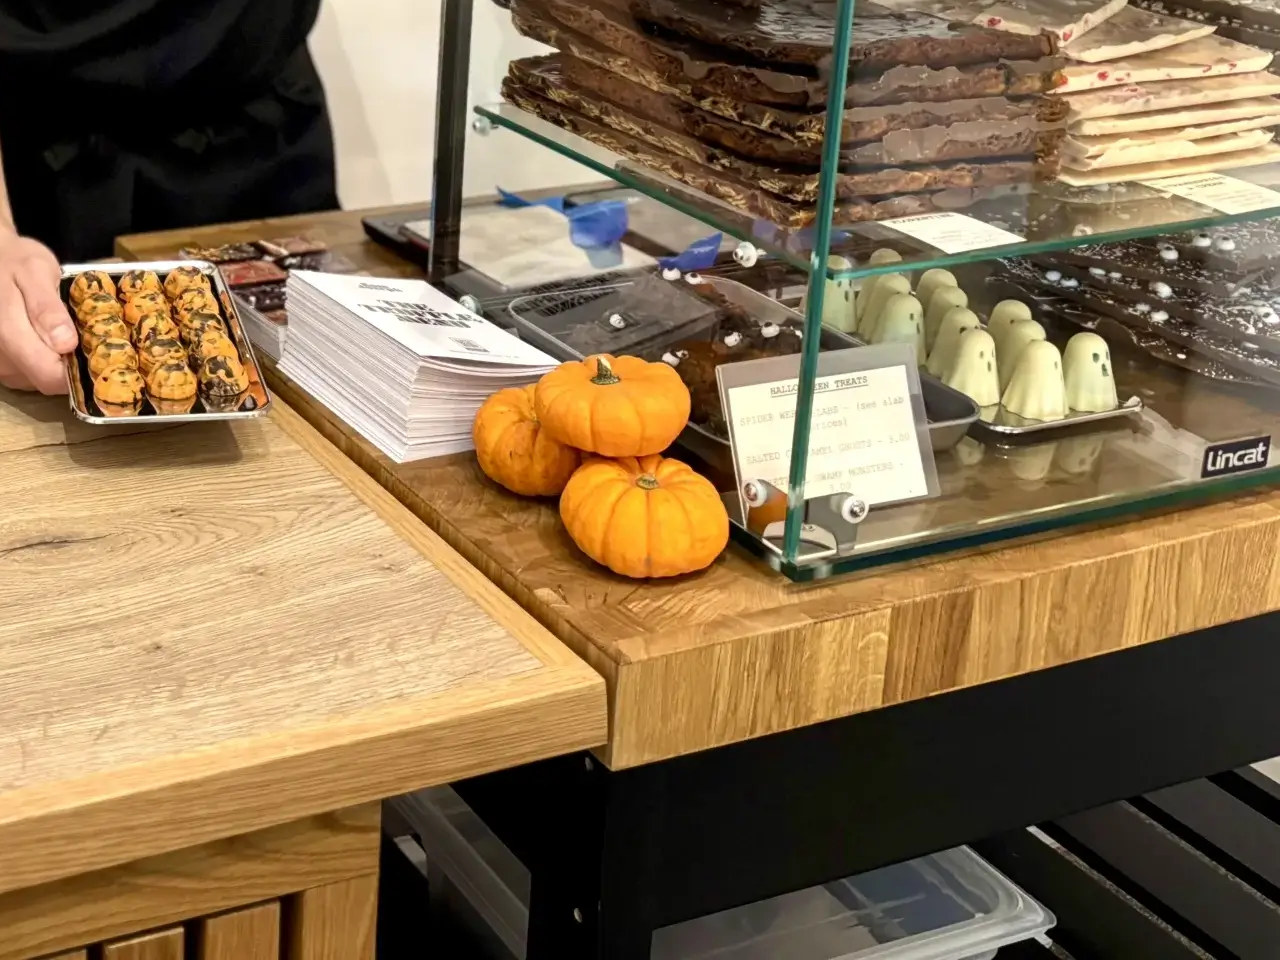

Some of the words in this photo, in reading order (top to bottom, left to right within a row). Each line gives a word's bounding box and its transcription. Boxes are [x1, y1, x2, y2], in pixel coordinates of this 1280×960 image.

[770, 381, 830, 395] HALLOEEN
[834, 376, 868, 389] TREATS
[740, 413, 774, 427] SPIDER
